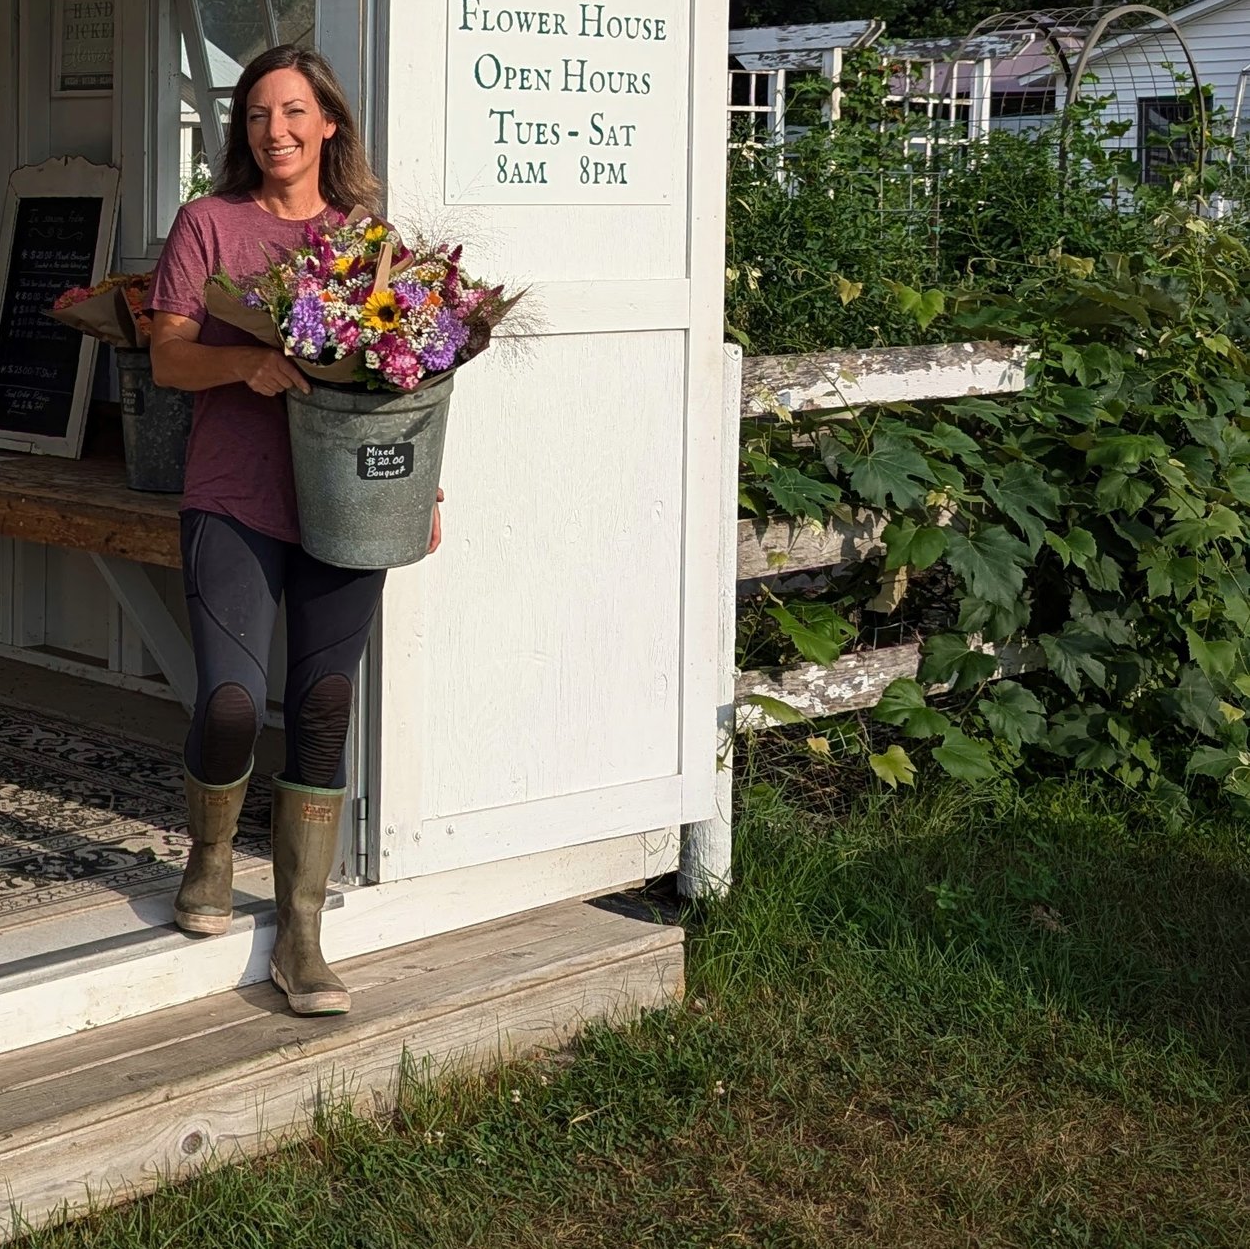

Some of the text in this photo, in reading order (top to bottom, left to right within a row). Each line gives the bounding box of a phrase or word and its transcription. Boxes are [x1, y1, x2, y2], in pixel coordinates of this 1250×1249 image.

[73, 1, 114, 19] HAND
[496, 154, 628, 185] 8AM 8PM
[366, 446, 395, 457] Mixed
[366, 465, 406, 478] Bouquet
